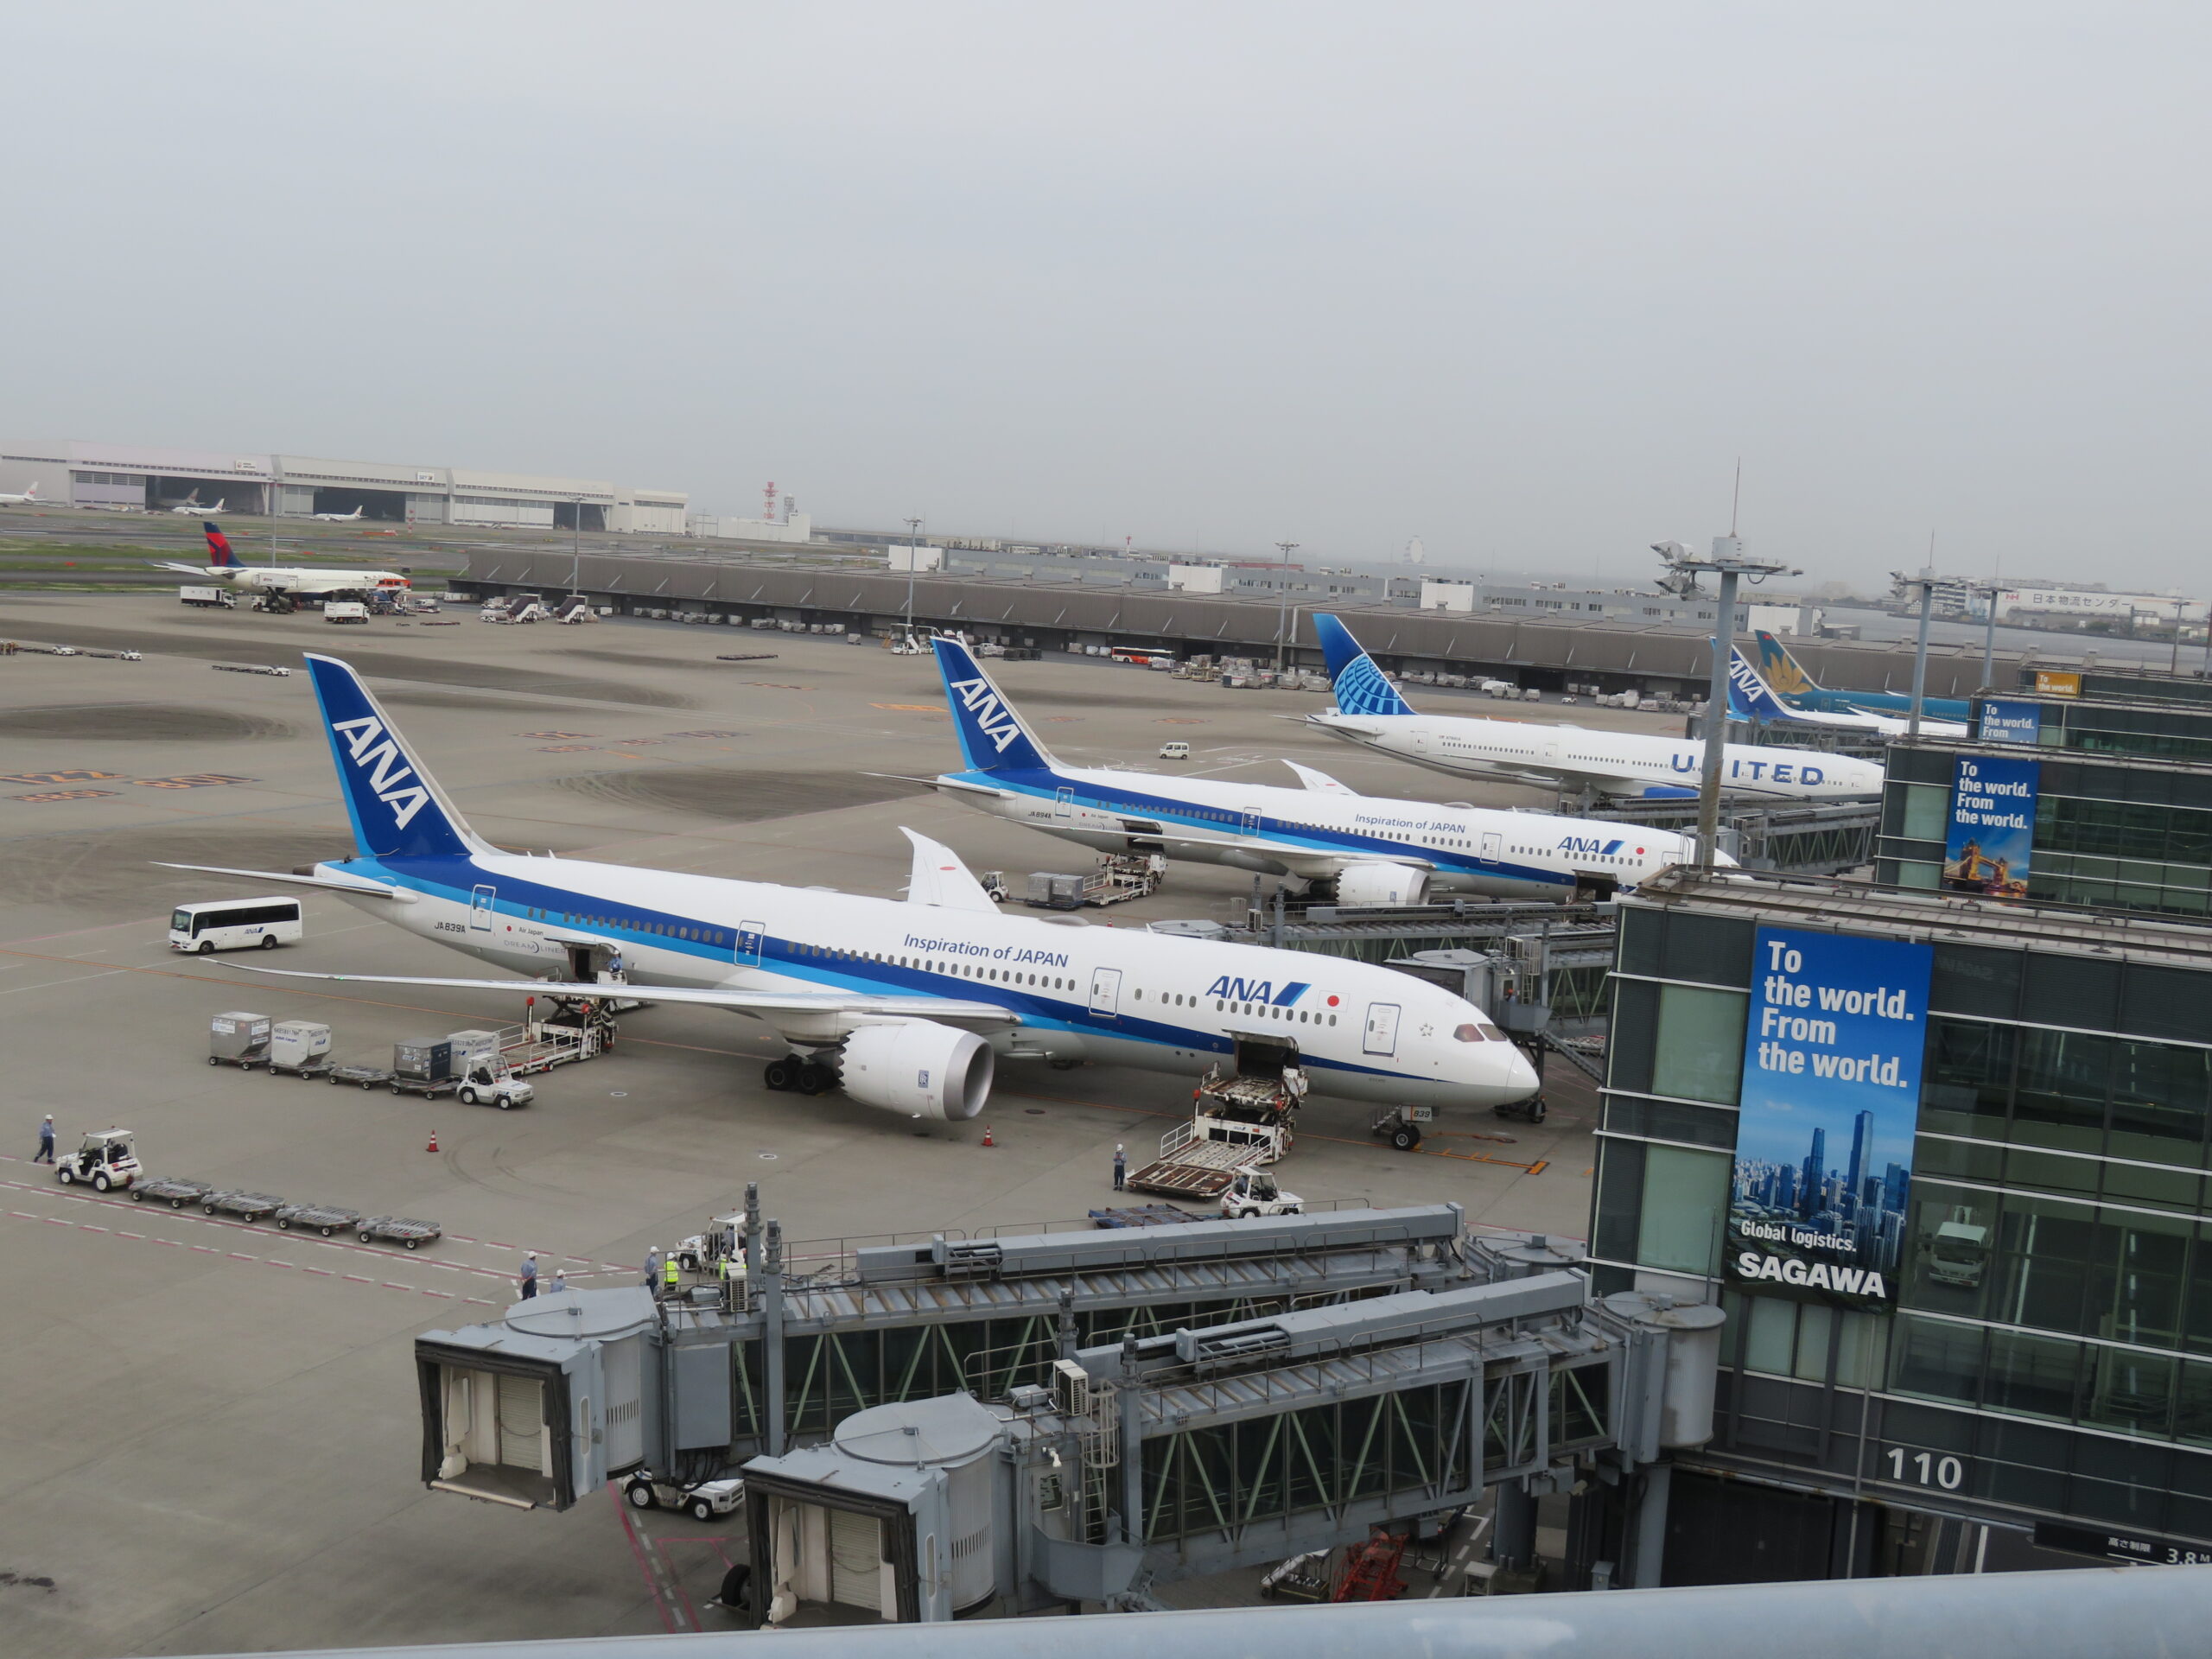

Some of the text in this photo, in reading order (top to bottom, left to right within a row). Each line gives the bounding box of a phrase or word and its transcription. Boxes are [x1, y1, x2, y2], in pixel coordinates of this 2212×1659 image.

[2033, 593, 2130, 607] 日本物流センター
[950, 677, 1020, 753] ANA
[1985, 704, 1997, 715] To
[1982, 726, 2009, 738] From
[1984, 715, 2034, 729] the world.
[332, 715, 429, 830] ANA
[1672, 753, 1823, 785] UITED
[1961, 761, 1978, 777] To
[1959, 778, 2031, 798] the world.
[1957, 792, 1993, 810] From
[1355, 814, 1466, 834] Inspiration of JAPAN
[1955, 809, 2028, 830] the world.
[1557, 836, 1600, 854] ANA
[434, 921, 467, 934] JA839A
[528, 928, 544, 937] Japan
[904, 933, 1069, 968] Inspiration of JAPAN
[1768, 940, 1802, 973] To
[1205, 976, 1272, 1004] ANA
[1764, 975, 1915, 1021] the world.
[1761, 1007, 1836, 1045] From
[1758, 1041, 1908, 1088] the world.
[1413, 1109, 1431, 1118] 839
[1741, 1220, 1857, 1253] Global logistics.
[1738, 1252, 1885, 1298] SAGAWA
[1887, 1447, 1962, 1490] 110
[2107, 1537, 2151, 1553] 高さ制限
[2166, 1548, 2196, 1565] 3.8
